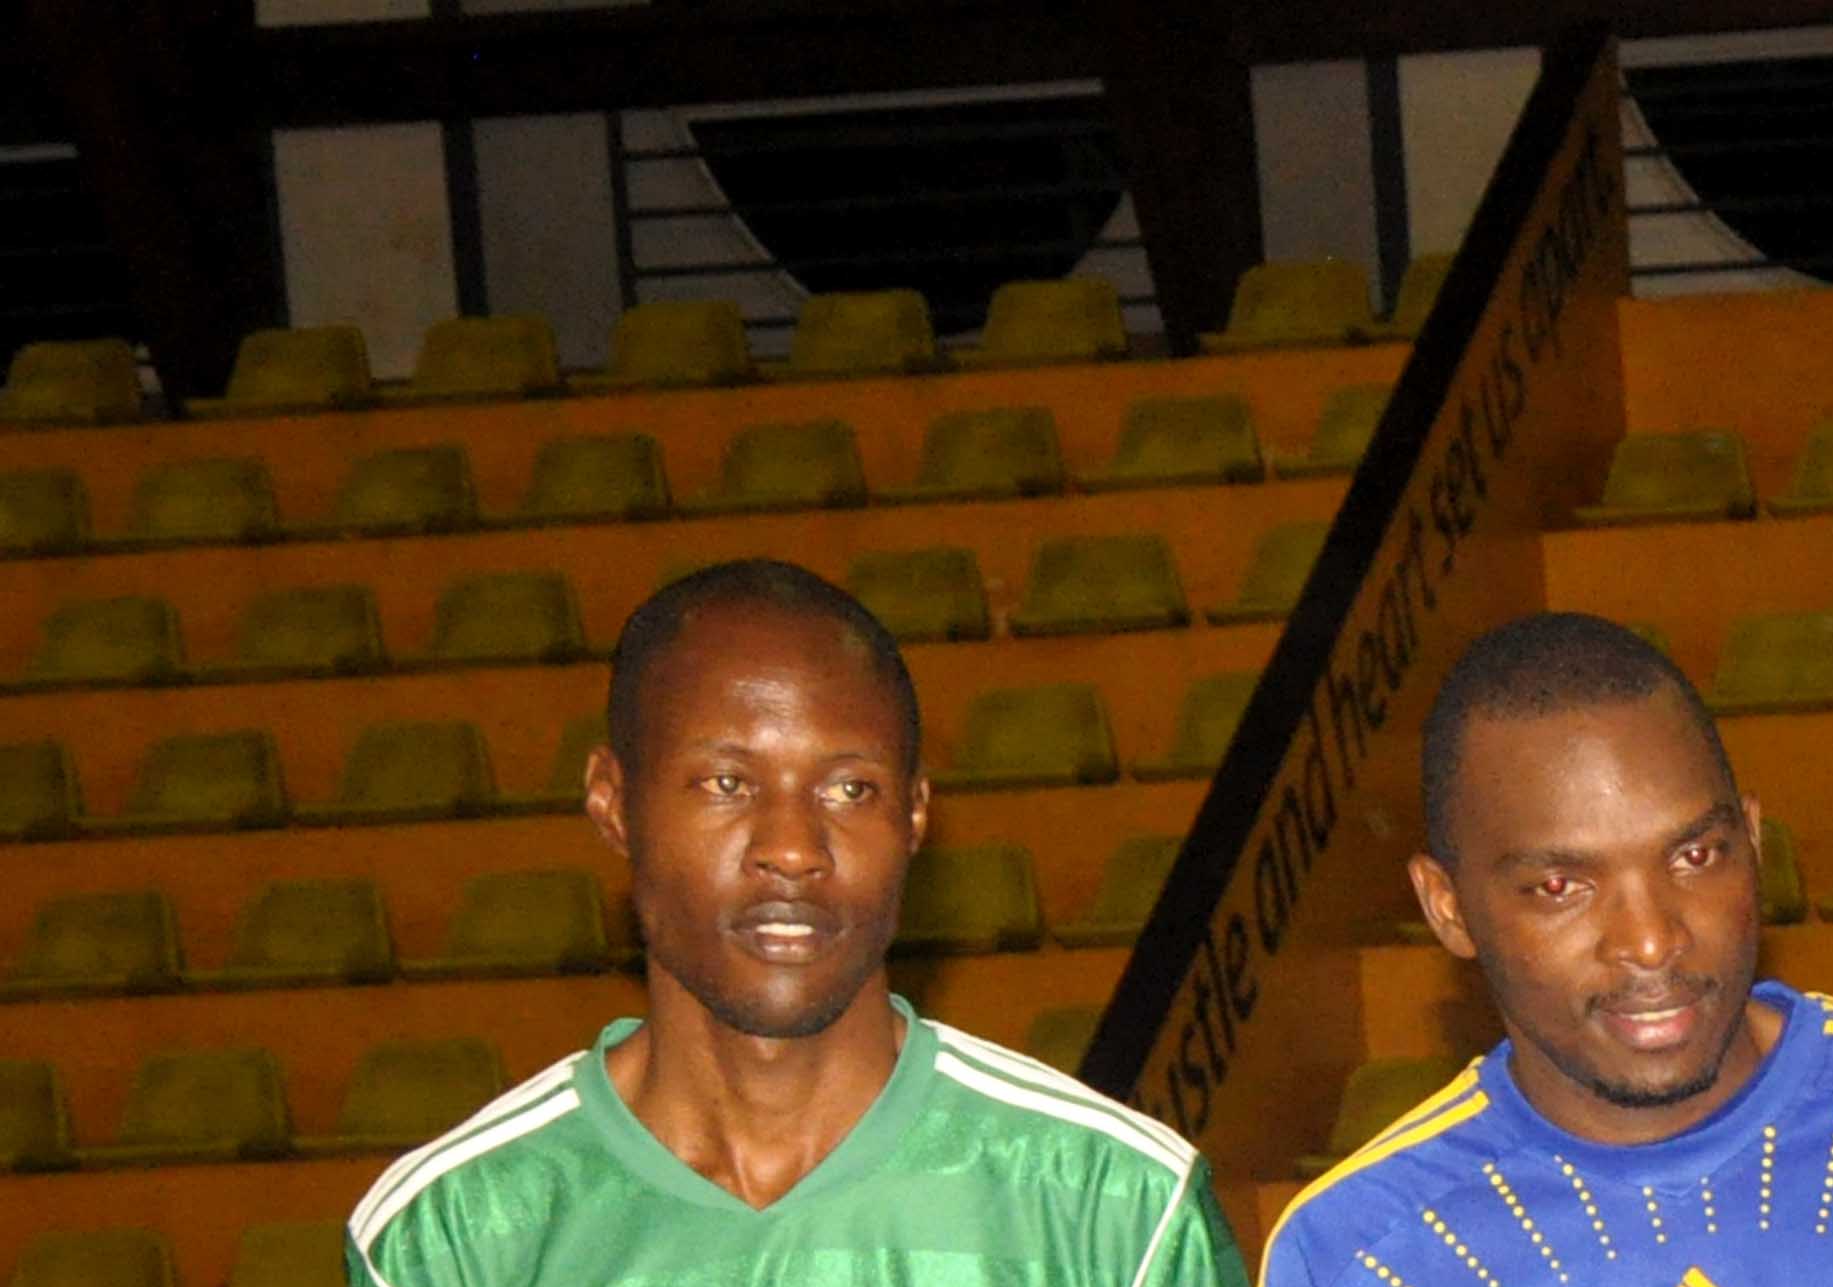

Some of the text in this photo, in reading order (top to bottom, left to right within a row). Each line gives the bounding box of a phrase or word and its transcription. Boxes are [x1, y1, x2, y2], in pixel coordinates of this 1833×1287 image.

[1253, 704, 1339, 956] and
[1326, 506, 1438, 788] heart
[1429, 405, 1488, 576] set
